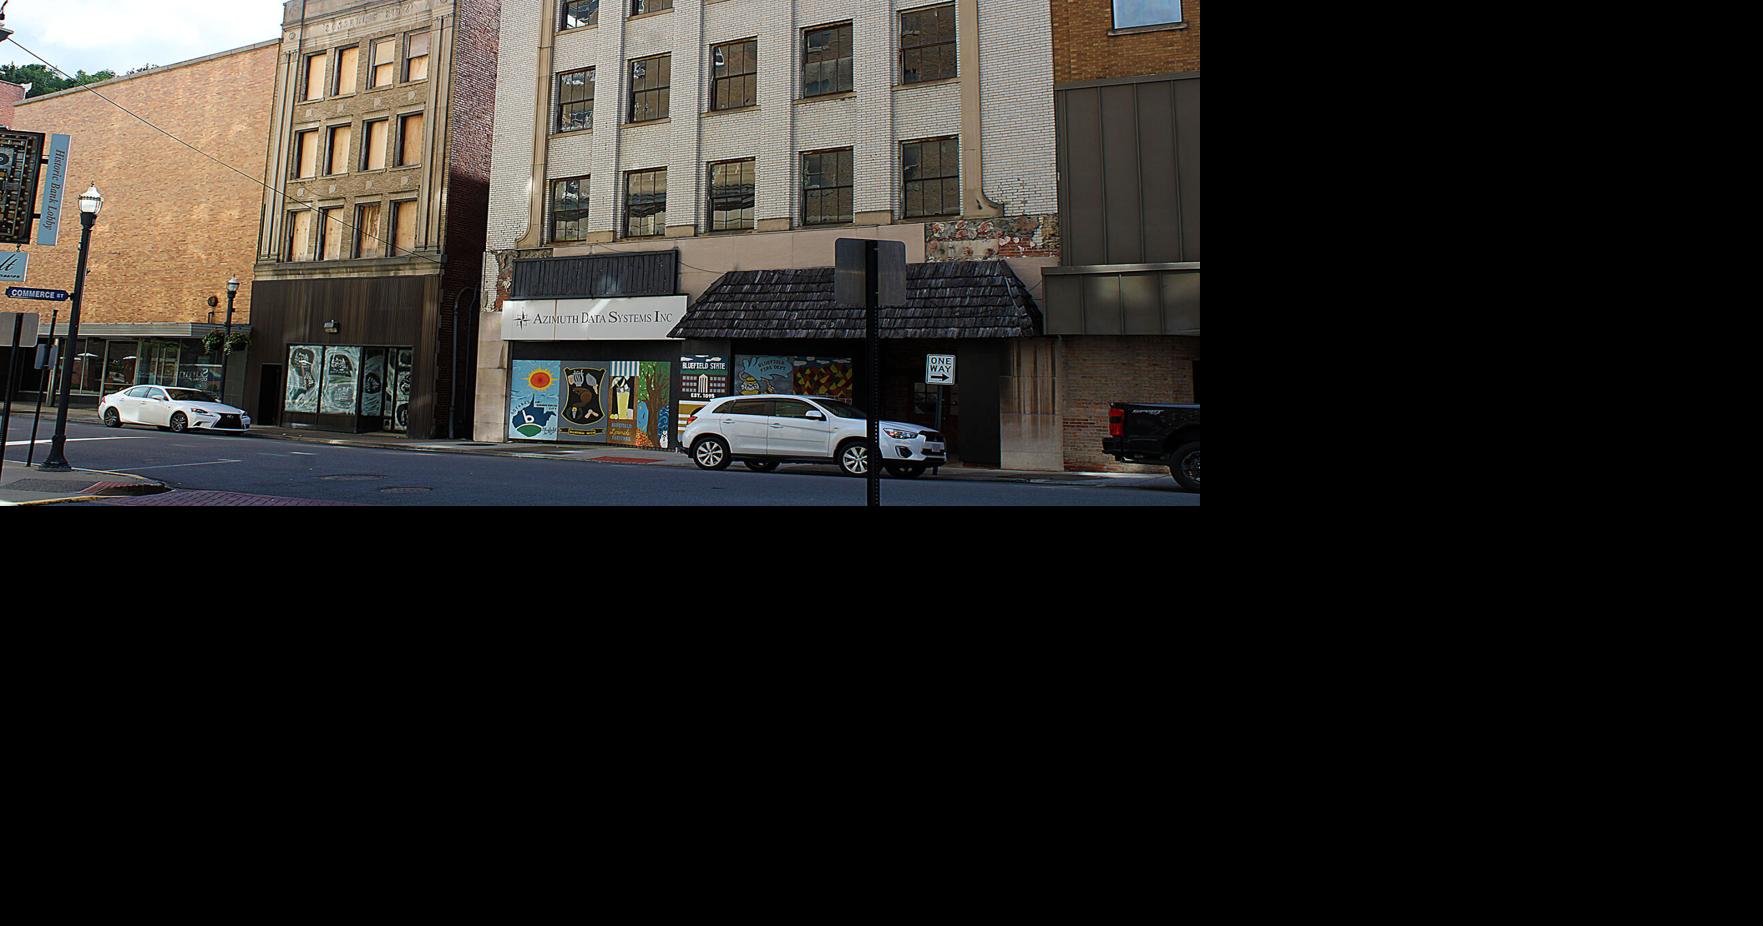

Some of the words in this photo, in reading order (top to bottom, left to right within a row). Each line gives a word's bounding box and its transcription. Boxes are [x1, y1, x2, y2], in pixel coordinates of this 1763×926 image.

[51, 149, 65, 182] Historic
[49, 183, 61, 205] Bank
[43, 205, 57, 230] Lobby
[11, 289, 55, 299] COMMERCE
[533, 313, 579, 324] AZIMUTH
[581, 311, 607, 324] DATA
[608, 310, 652, 324] SYSTEMS
[655, 310, 673, 323] INC
[682, 362, 709, 370] BLUEFIELD
[710, 362, 726, 370] STATE
[931, 357, 951, 365] ONE
[930, 365, 951, 373] WAY
